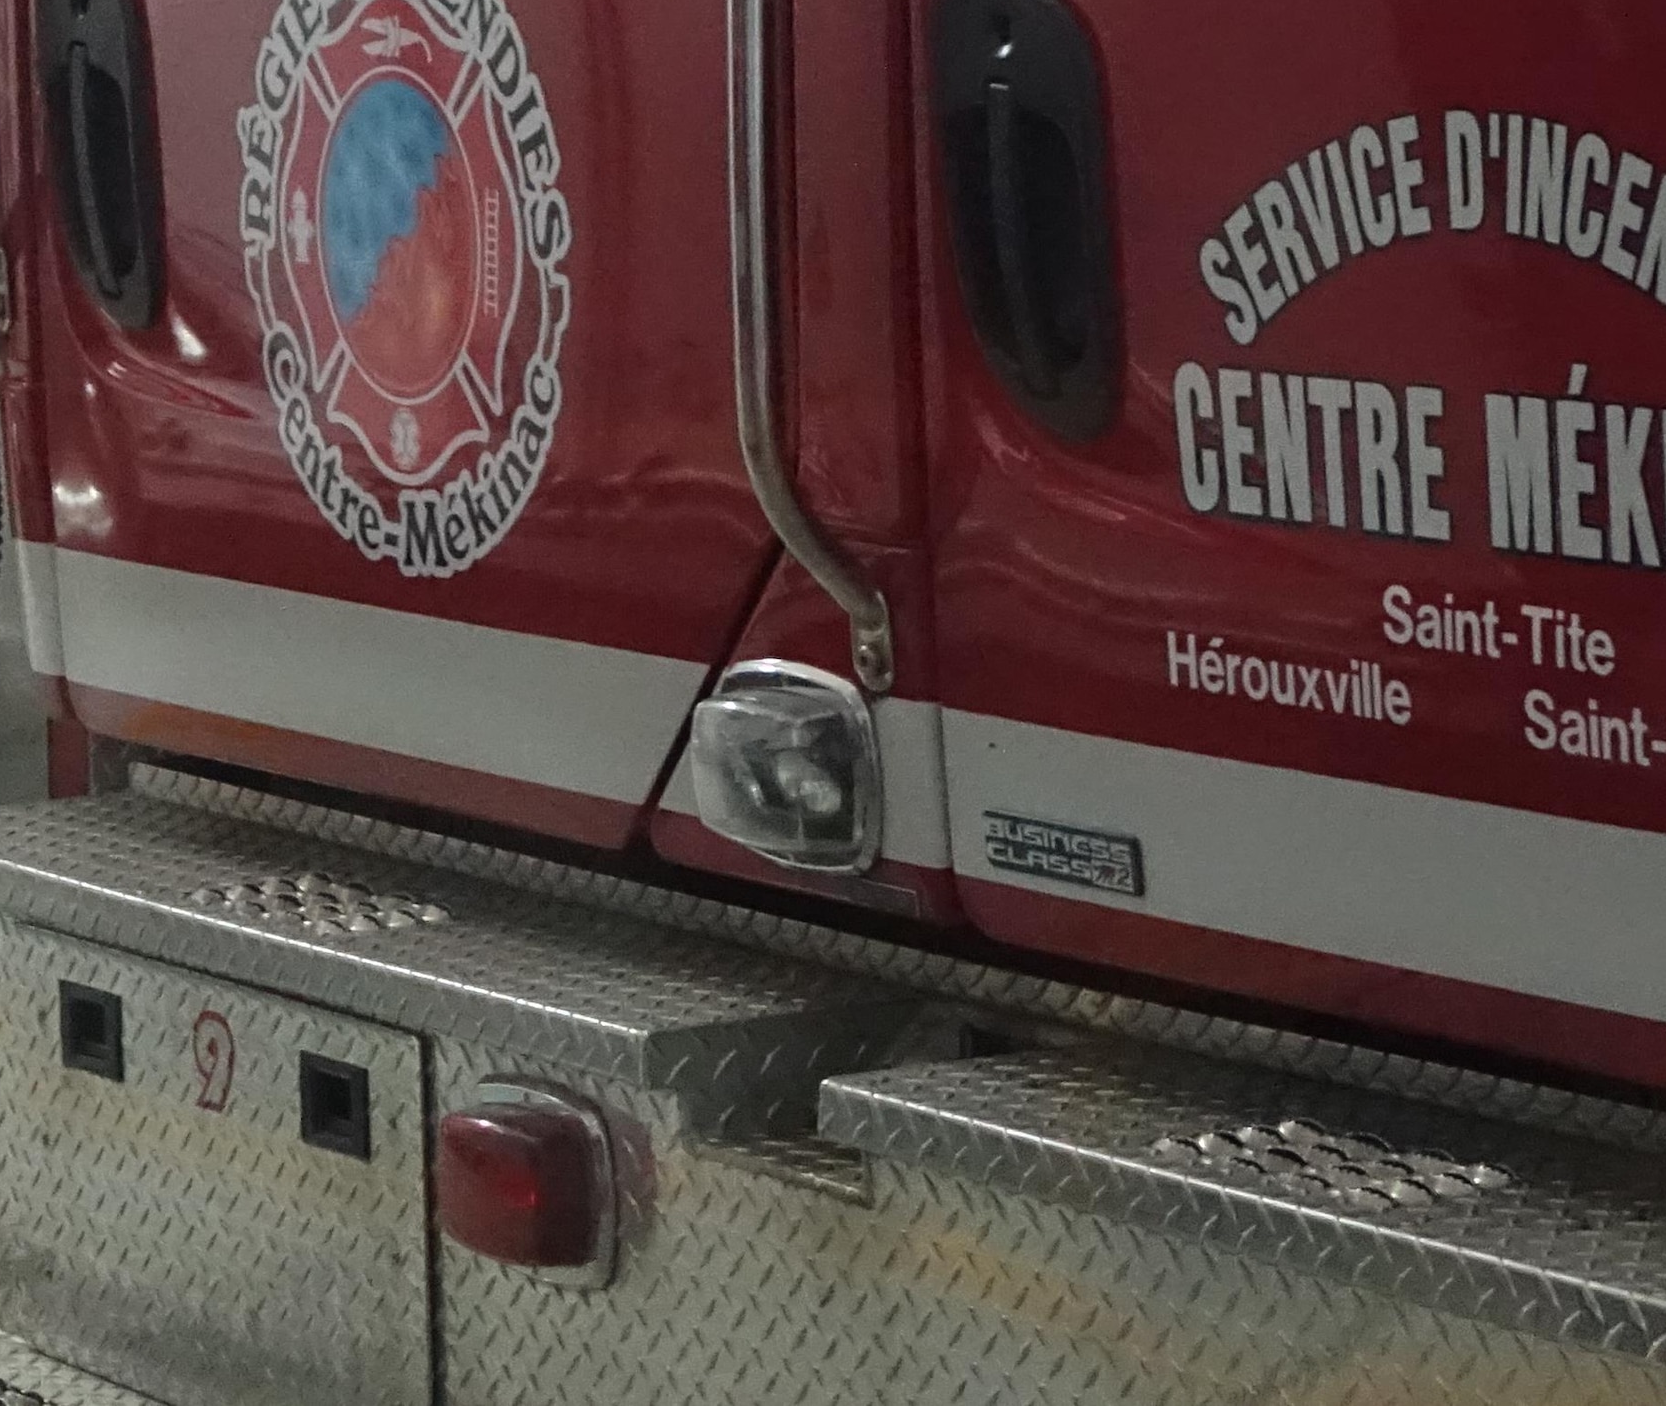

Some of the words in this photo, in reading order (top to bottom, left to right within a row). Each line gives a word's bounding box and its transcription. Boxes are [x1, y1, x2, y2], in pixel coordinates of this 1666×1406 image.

[1197, 113, 1432, 346] SERVICE
[264, 326, 561, 574] Centre-Mékinac
[1173, 360, 1452, 542] CENTRE
[1166, 631, 1413, 727] Hérouxville
[1382, 584, 1616, 677] Saint-Tite
[986, 841, 1095, 880] CLASS
[193, 1010, 236, 1113] 9
